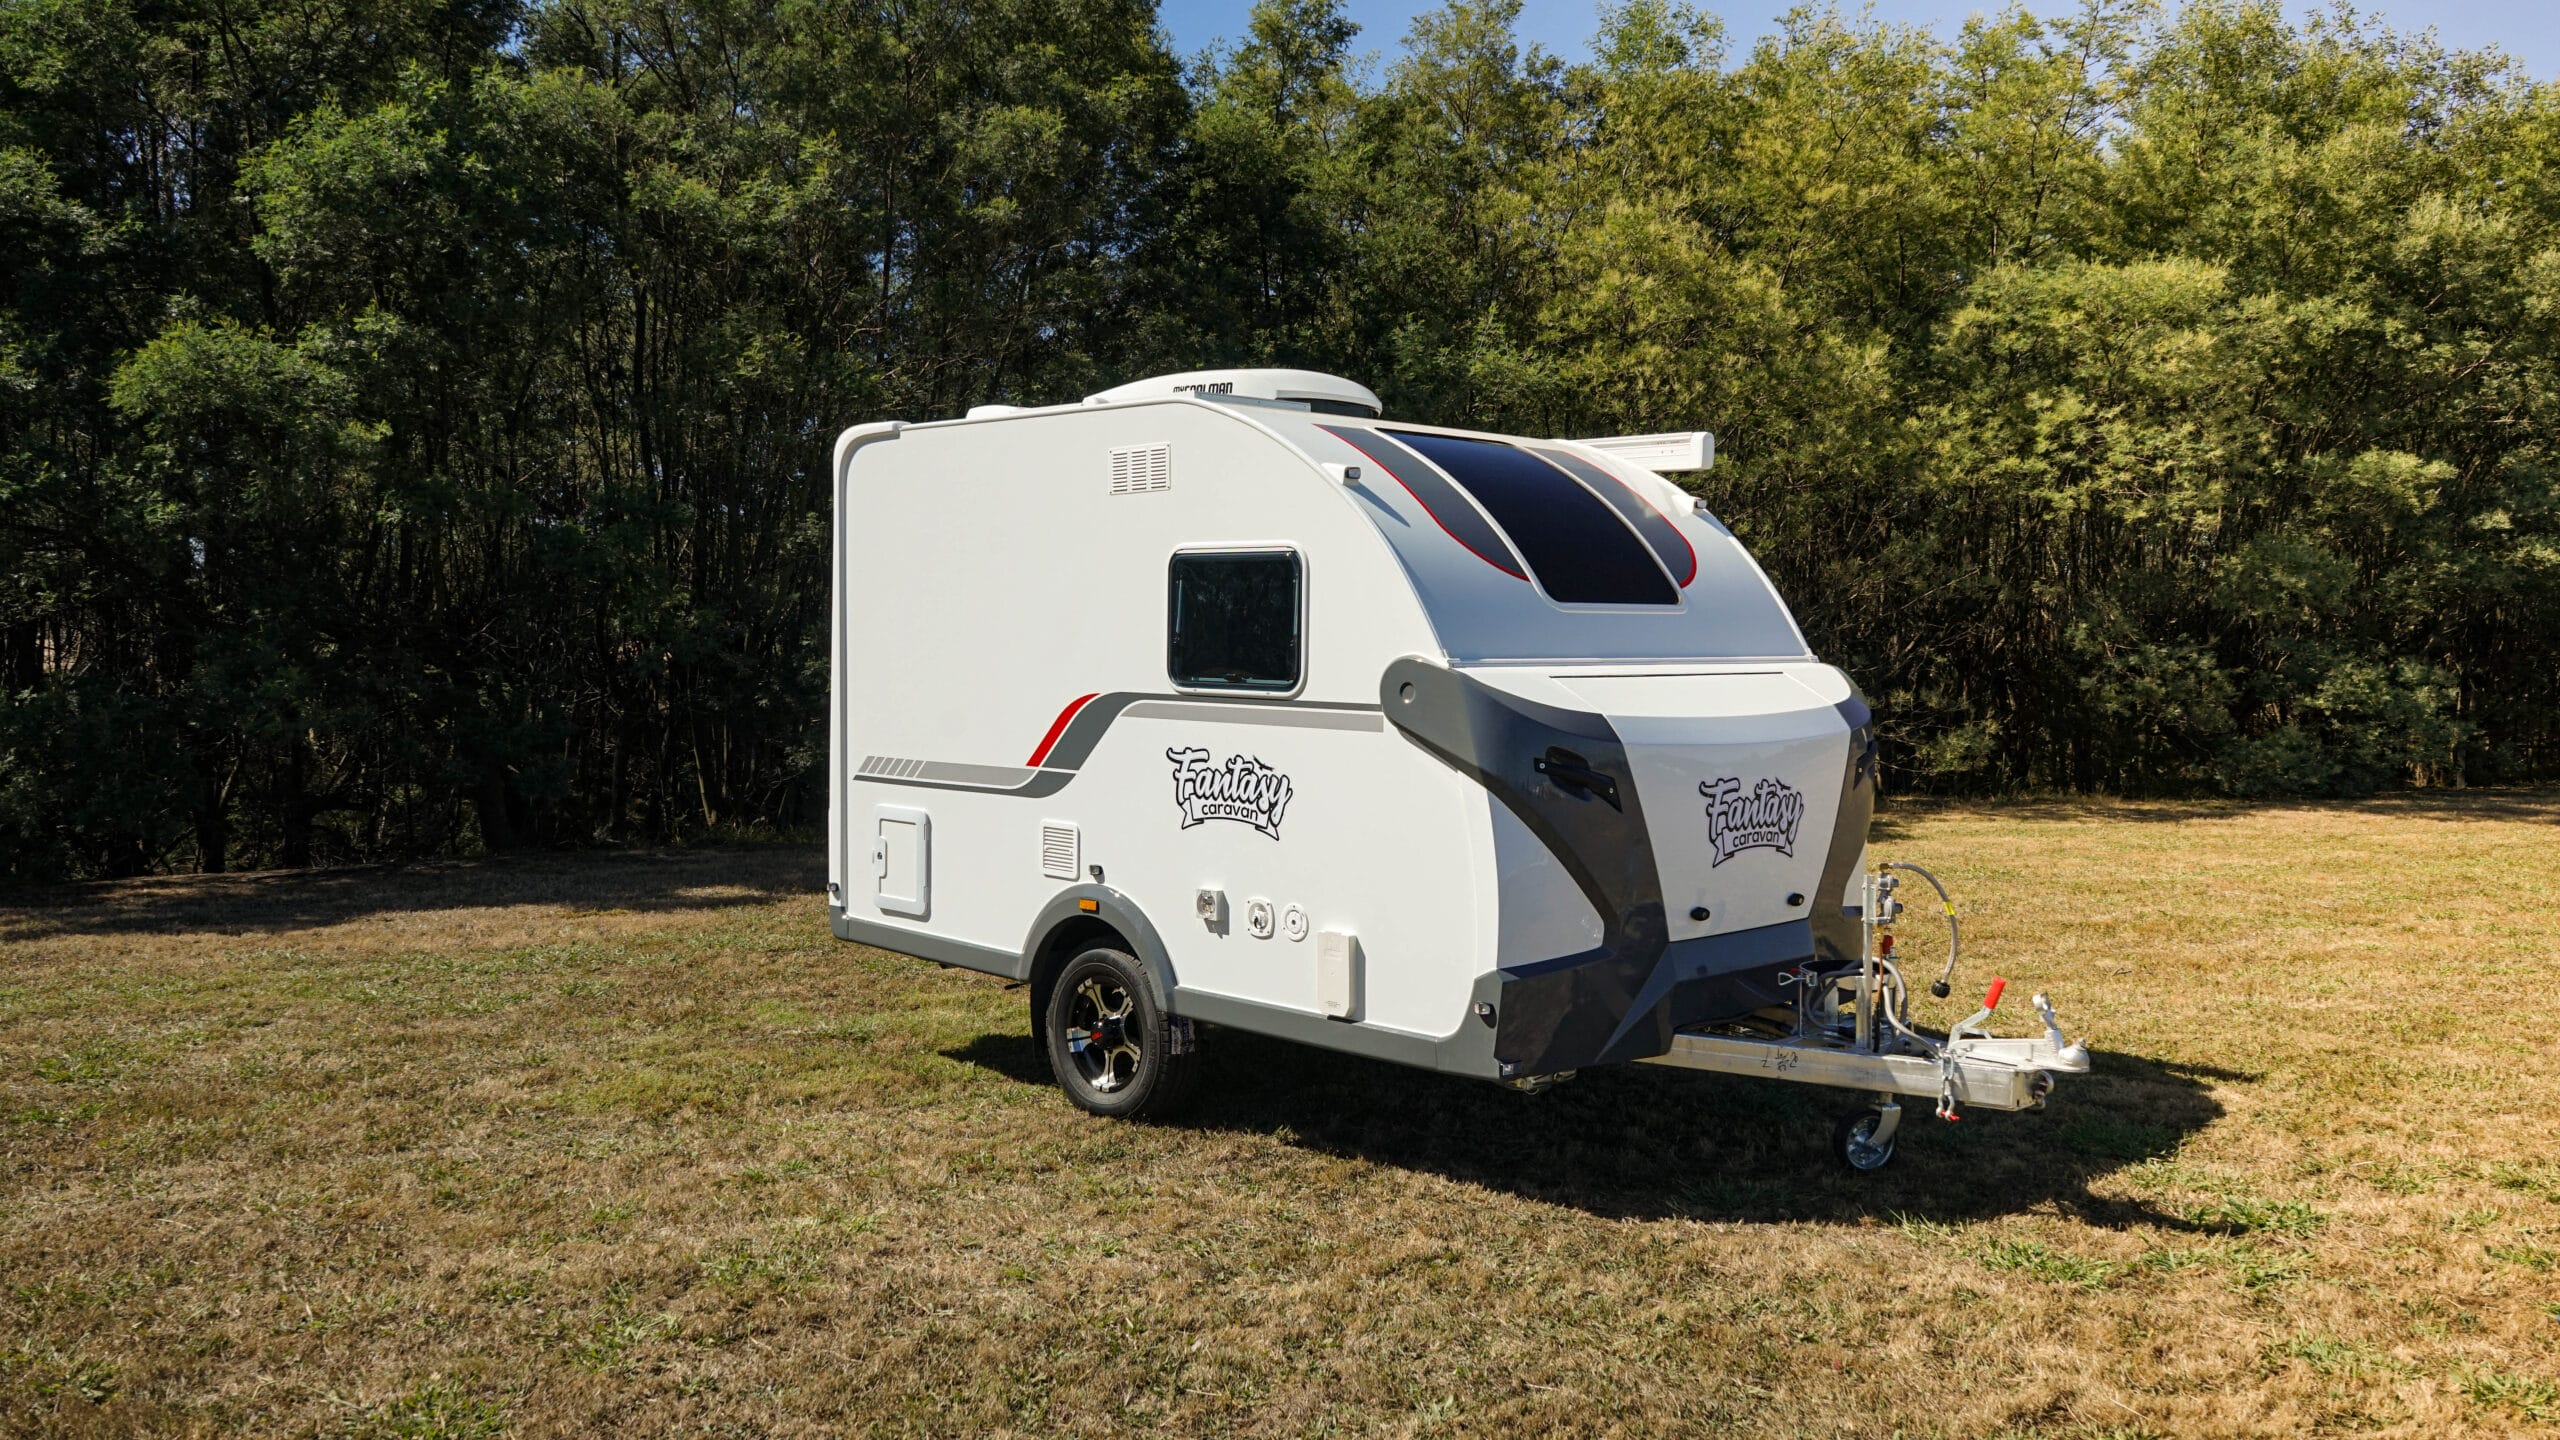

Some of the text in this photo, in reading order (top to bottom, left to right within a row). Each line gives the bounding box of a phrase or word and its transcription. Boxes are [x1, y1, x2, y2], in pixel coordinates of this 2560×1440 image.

[1166, 747, 1293, 827] Fantasy
[1201, 803, 1258, 821] caravan
[1699, 777, 1804, 845] Fantasy
[1732, 831, 1780, 847] caravan
